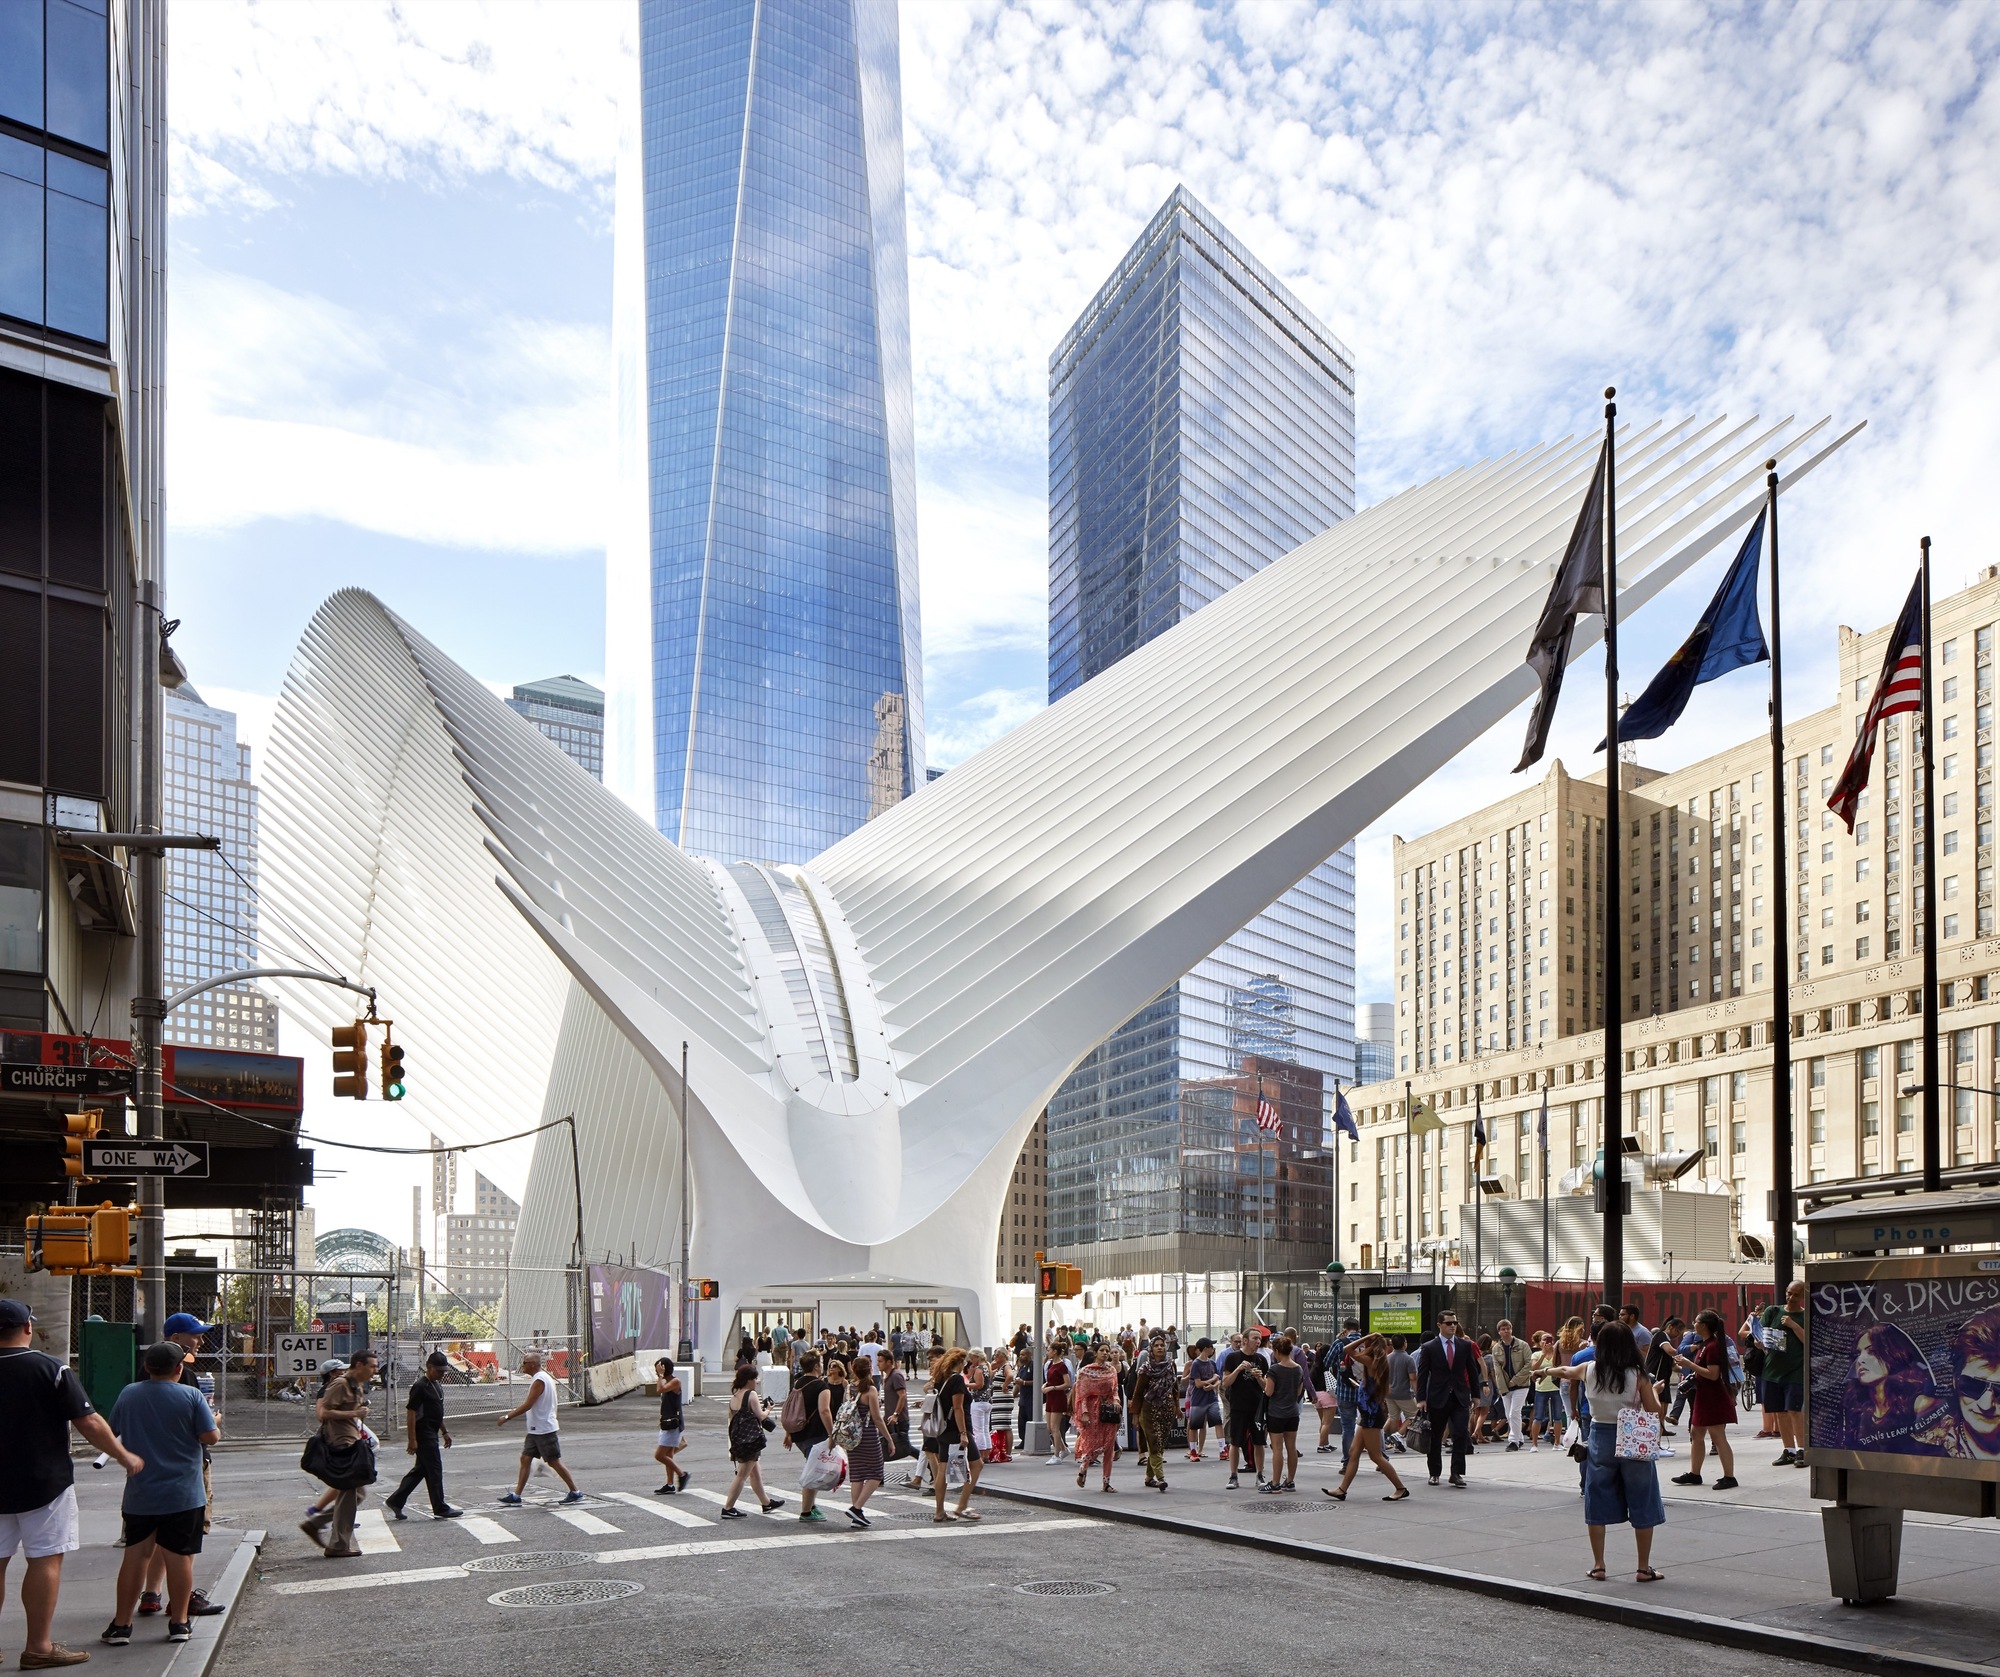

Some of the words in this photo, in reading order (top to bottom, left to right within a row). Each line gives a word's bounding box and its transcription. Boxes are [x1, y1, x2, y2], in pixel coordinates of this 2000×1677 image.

[11, 1070, 76, 1087] CHURCH
[77, 1074, 87, 1082] ST
[102, 1151, 137, 1165] ONE
[153, 1152, 190, 1166] WAY
[1873, 1227, 1950, 1240] Phone
[1813, 1281, 1879, 1321] SEX
[1882, 1293, 1904, 1315] &
[1904, 1277, 1999, 1315] DRUGS
[281, 1338, 327, 1351] GATE
[293, 1359, 317, 1372] 3B
[1170, 1428, 1188, 1438] TRAS
[1886, 1426, 1908, 1439] LEARY
